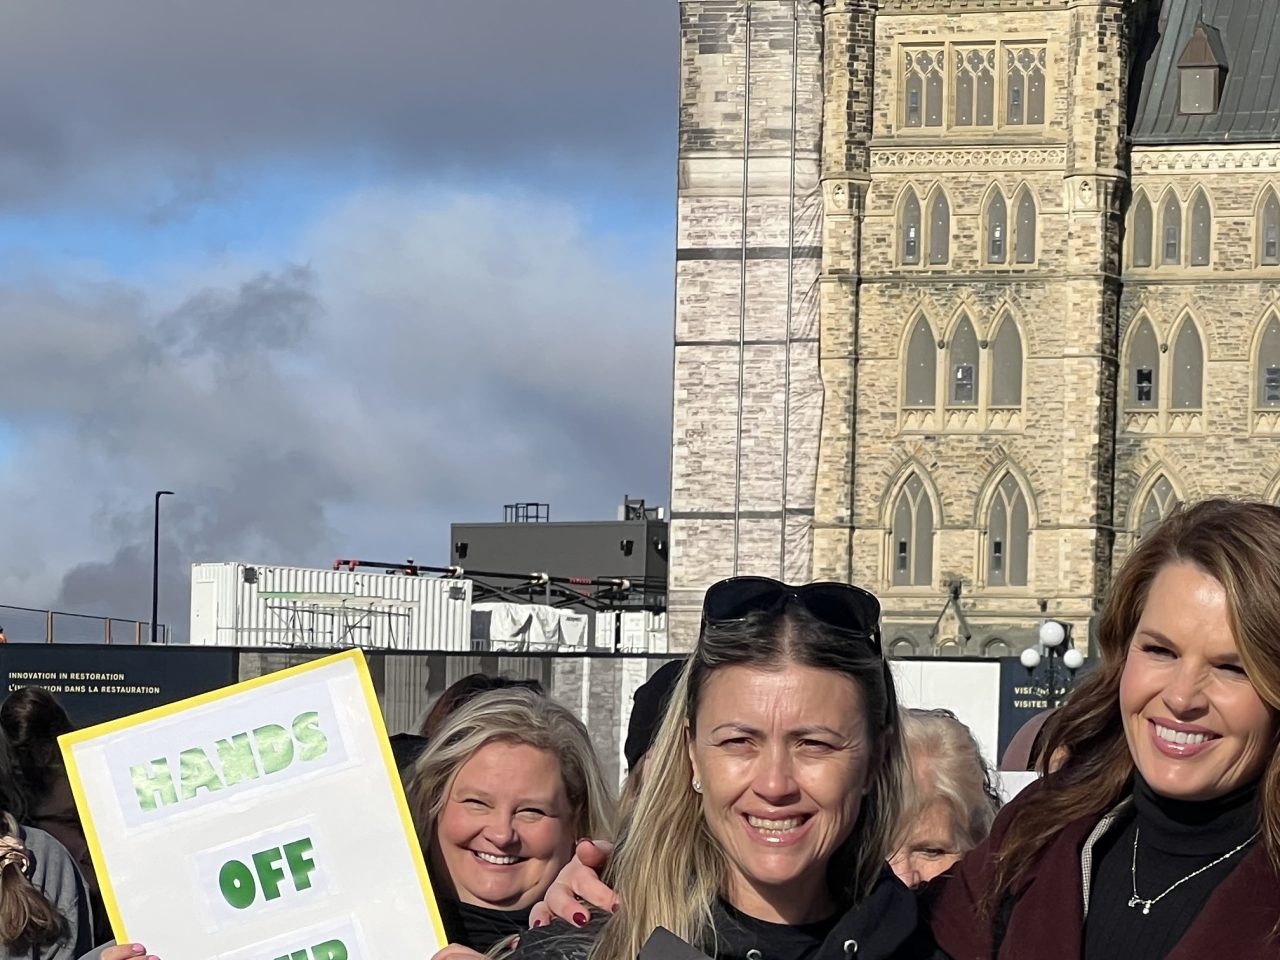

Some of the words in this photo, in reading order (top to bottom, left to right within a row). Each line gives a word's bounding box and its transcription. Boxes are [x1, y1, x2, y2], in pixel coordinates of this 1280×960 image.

[8, 672, 57, 680] INNOVATION
[70, 673, 125, 681] RESTORATION
[64, 685, 86, 693] DANS
[88, 685, 99, 693] LA
[101, 686, 160, 694] RESTAURATION
[130, 711, 329, 812] HANDS
[218, 836, 317, 910] OFF
